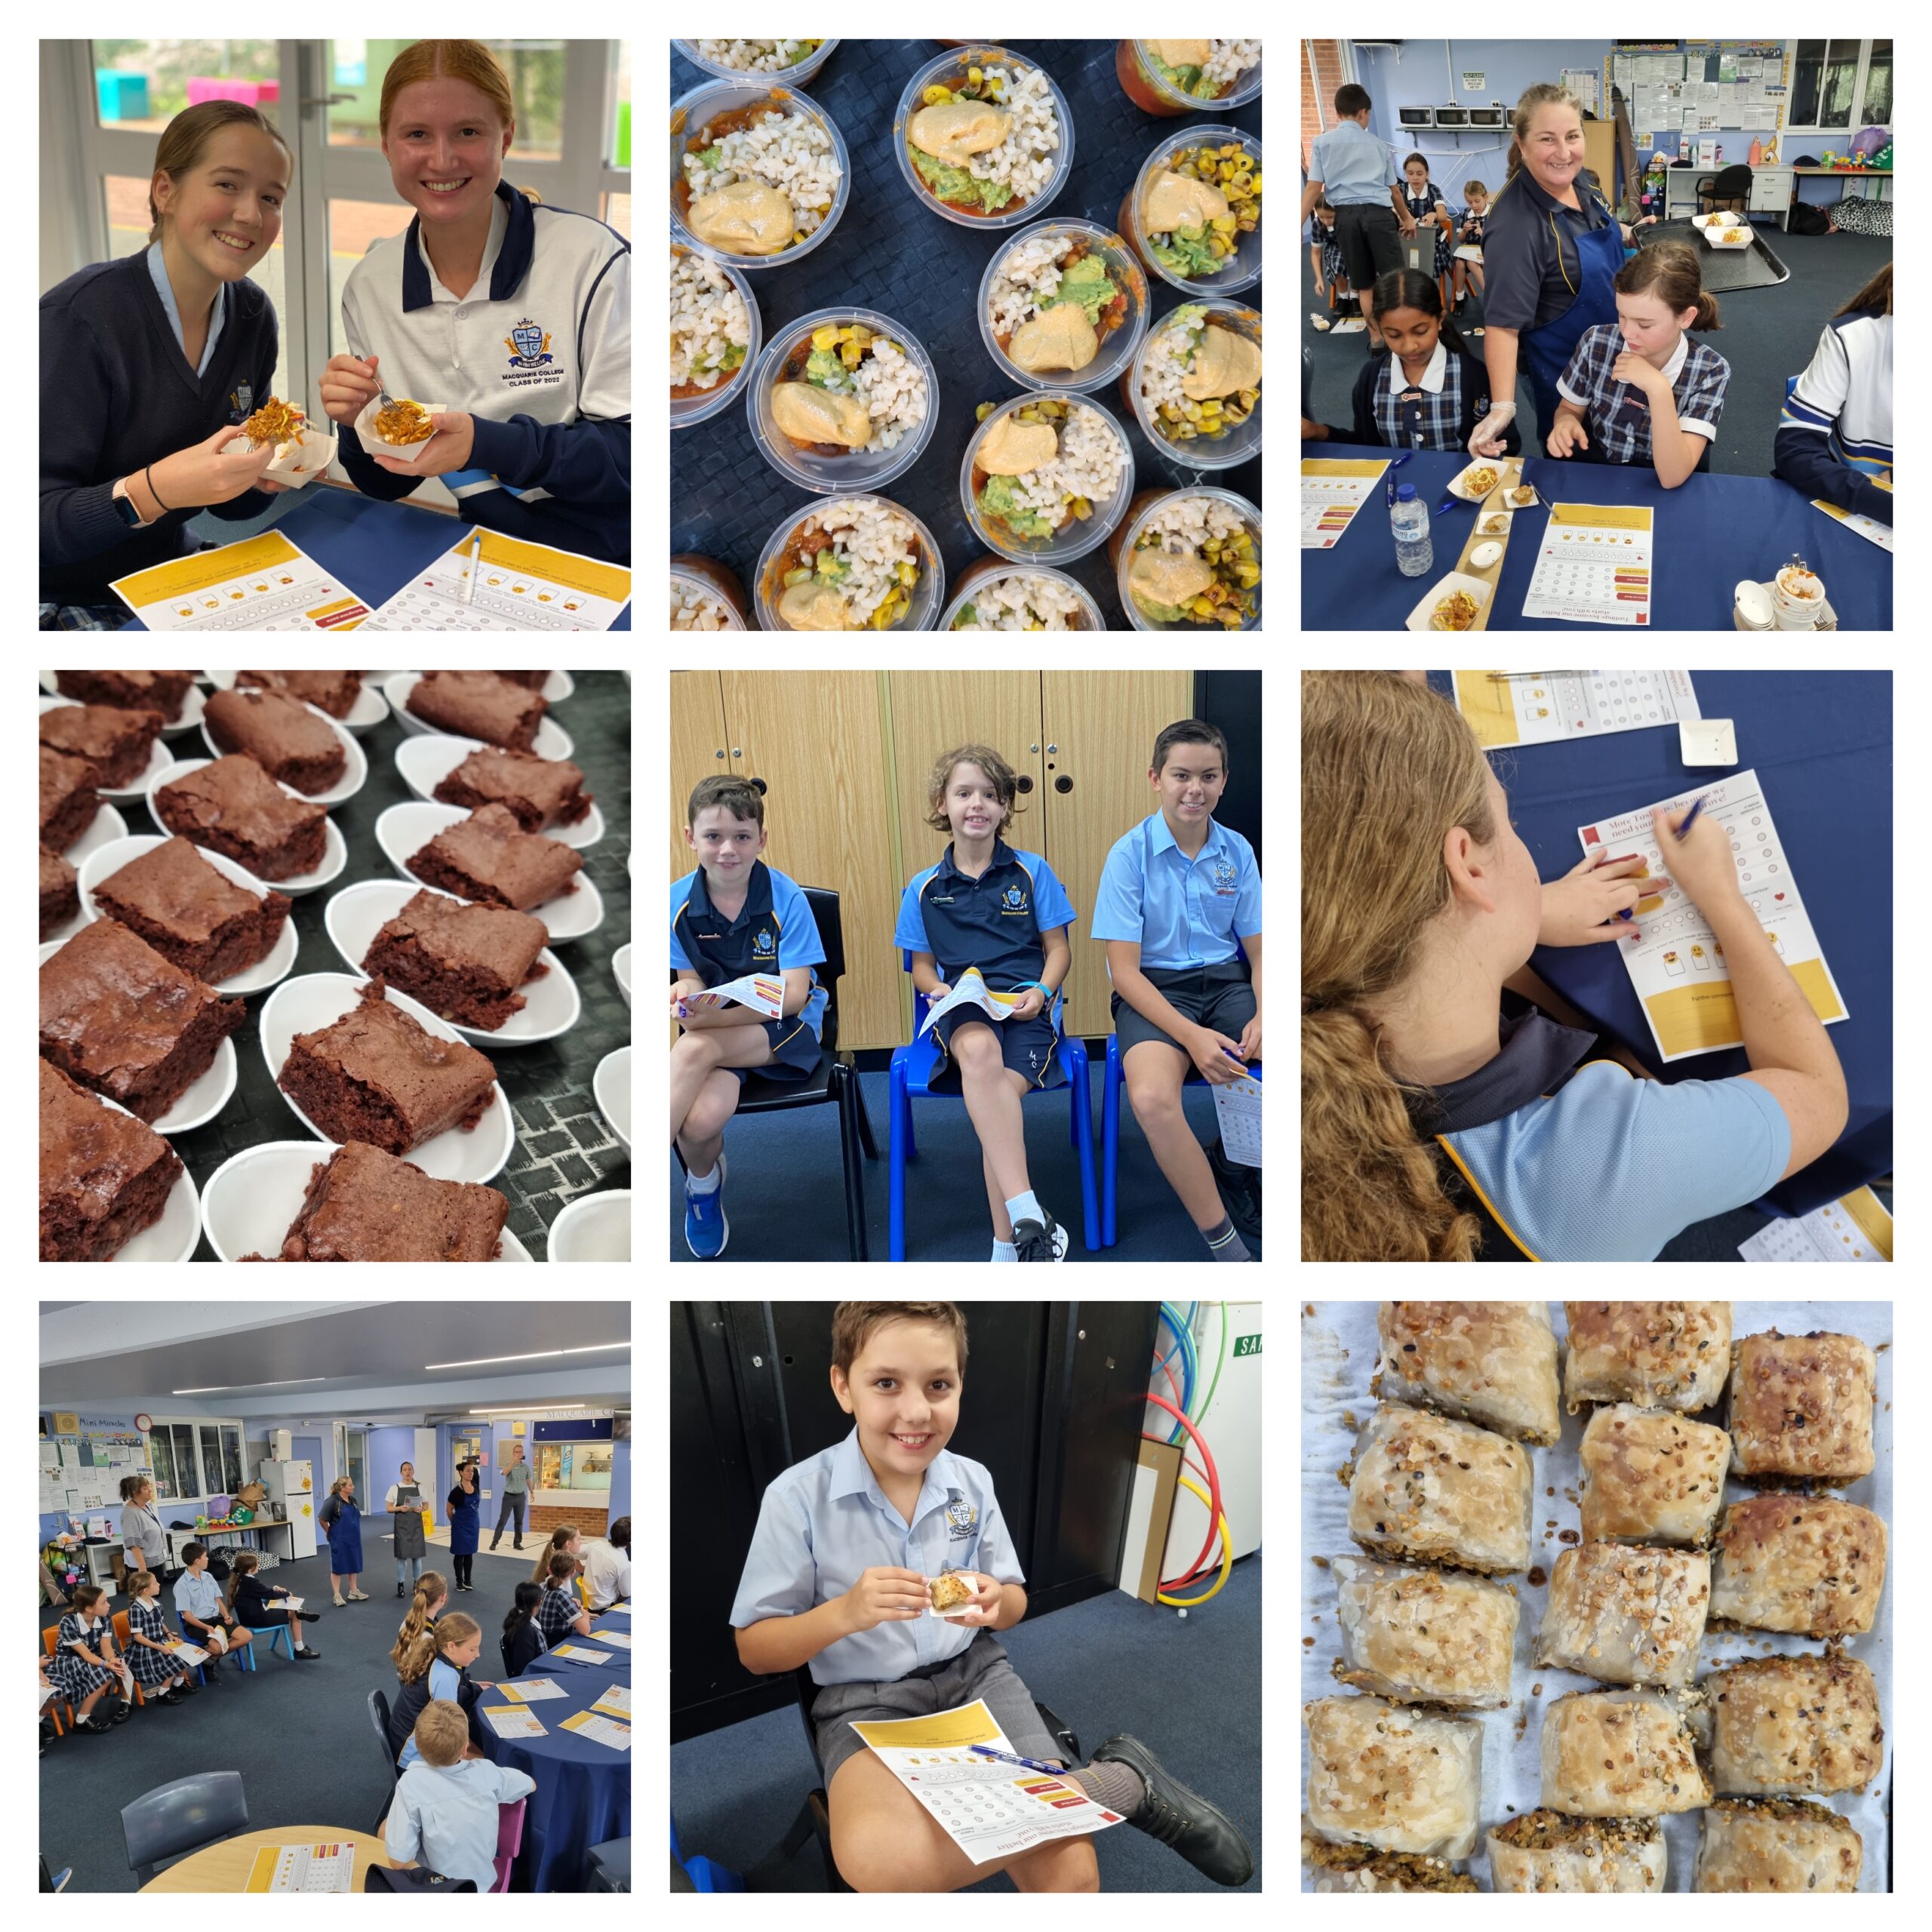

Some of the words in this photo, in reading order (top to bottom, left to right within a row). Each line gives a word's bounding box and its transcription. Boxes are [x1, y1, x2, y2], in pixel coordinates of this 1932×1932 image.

[1686, 49, 1724, 58] PARENT
[502, 371, 537, 380] MACQUARIE
[538, 368, 565, 377] COLLEGE
[1573, 612, 1599, 620] because
[1609, 817, 1630, 829] More
[1634, 802, 1674, 823] Tastgs:
[1674, 792, 1711, 809] because
[1712, 786, 1726, 795] we
[1612, 825, 1634, 838] need
[1634, 820, 1655, 835] your
[546, 1409, 596, 1419] MACQUARIE
[79, 1417, 97, 1427] Mini
[99, 1418, 127, 1428] Miracles
[1015, 1827, 1035, 1838] you!
[1023, 1833, 1038, 1841] our
[996, 1839, 1024, 1851] better
